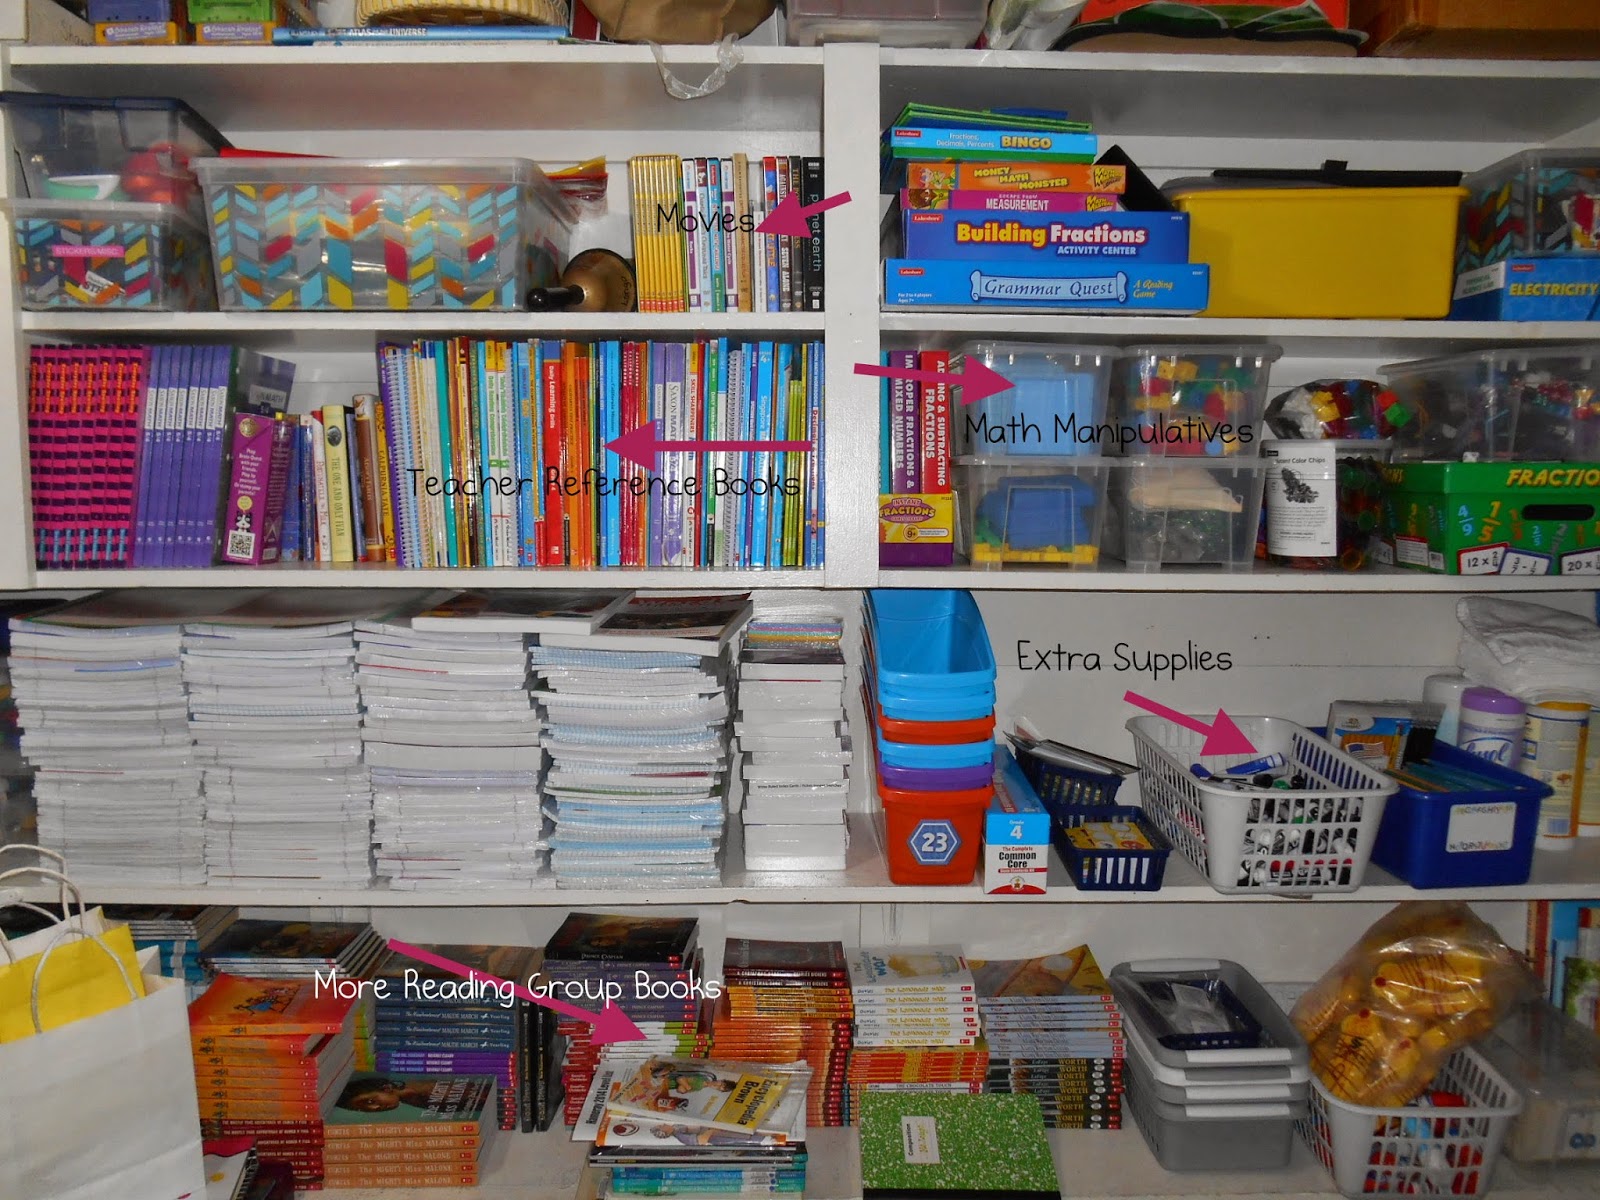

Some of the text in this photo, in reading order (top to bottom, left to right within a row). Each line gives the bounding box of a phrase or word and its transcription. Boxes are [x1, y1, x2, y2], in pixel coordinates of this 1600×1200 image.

[1001, 136, 1052, 149] BINGO
[973, 166, 1011, 178] MONEY
[999, 172, 1030, 183] MATH
[1018, 178, 1069, 190] MONSTER
[986, 198, 1050, 211] MEASUREMENT
[956, 222, 1147, 249] Building Fractions
[812, 237, 822, 272] earth
[1057, 246, 1137, 255] ACTIVITY CENTER
[984, 279, 1114, 298] Grammar Quest
[1509, 284, 1598, 296] ELECTRICITY
[548, 381, 557, 413] Learning
[669, 385, 679, 414] SAXON
[759, 395, 768, 430] Singapore
[905, 354, 915, 489] IMROPER FRACTIONS &
[895, 377, 904, 469] MIXED NUMBERS
[925, 389, 936, 459] FRACTIONS
[937, 360, 946, 486] ADING & SUBTRACTING
[378, 450, 390, 517] CALPURNIA TATE
[331, 457, 345, 537] THE ONE AND ONLY IVAN
[879, 506, 936, 518] FRACTIONS
[907, 530, 916, 538] 9+
[1467, 557, 1479, 567] 12
[1567, 561, 1582, 571] 20
[1010, 825, 1023, 839] 4
[921, 832, 948, 852] 23
[999, 852, 1037, 861] Common
[1007, 860, 1028, 868] Core
[736, 1080, 761, 1107] Brown
[740, 1078, 778, 1126] Encyclopedia
[906, 1123, 914, 1156] Composition
